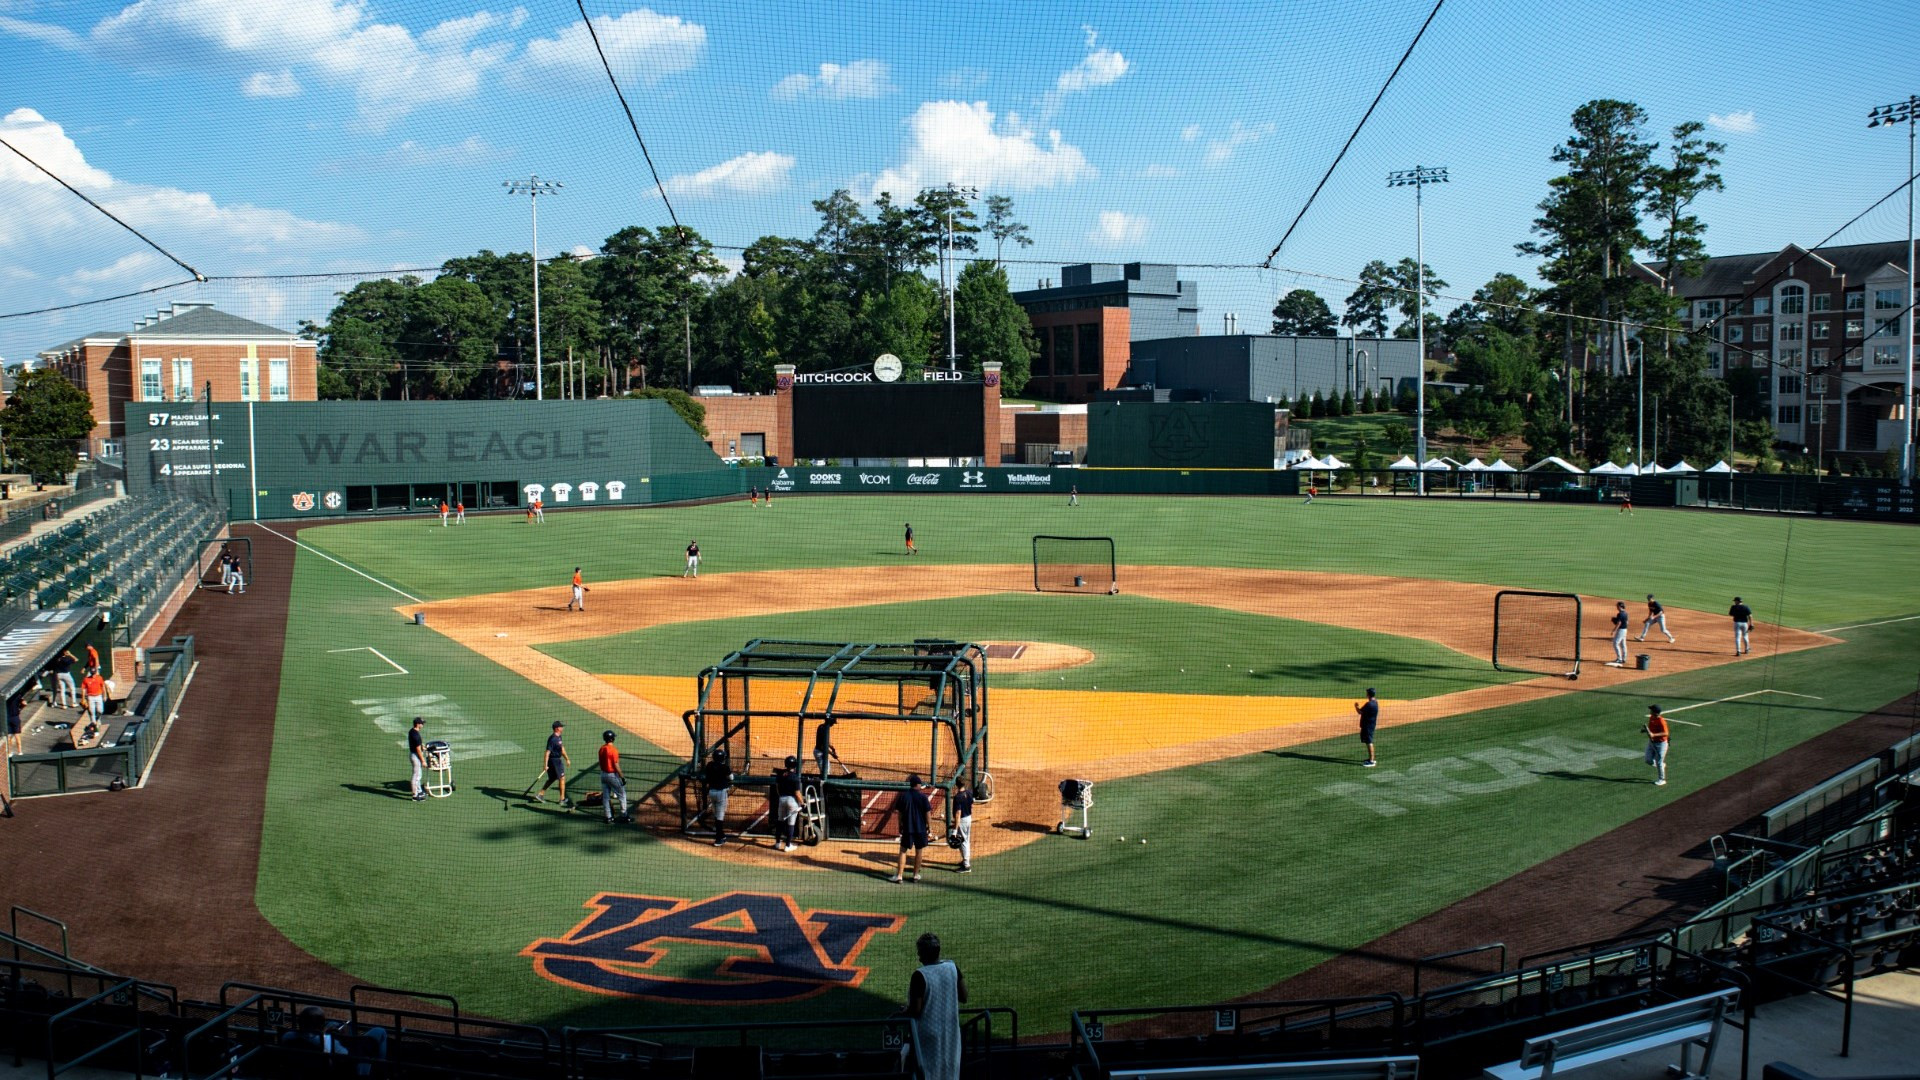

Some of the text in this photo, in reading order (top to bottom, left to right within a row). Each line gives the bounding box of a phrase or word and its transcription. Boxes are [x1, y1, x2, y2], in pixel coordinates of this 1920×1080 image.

[794, 371, 962, 383] HITCHCOCK FIELD
[149, 413, 169, 426] 57
[150, 438, 170, 451] 23
[297, 430, 610, 465] WAR EAGLE
[160, 463, 171, 476] 4
[1636, 956, 1647, 967] 34
[269, 1011, 282, 1022] 37
[1086, 1027, 1102, 1038] 35
[885, 1034, 900, 1046] 36
